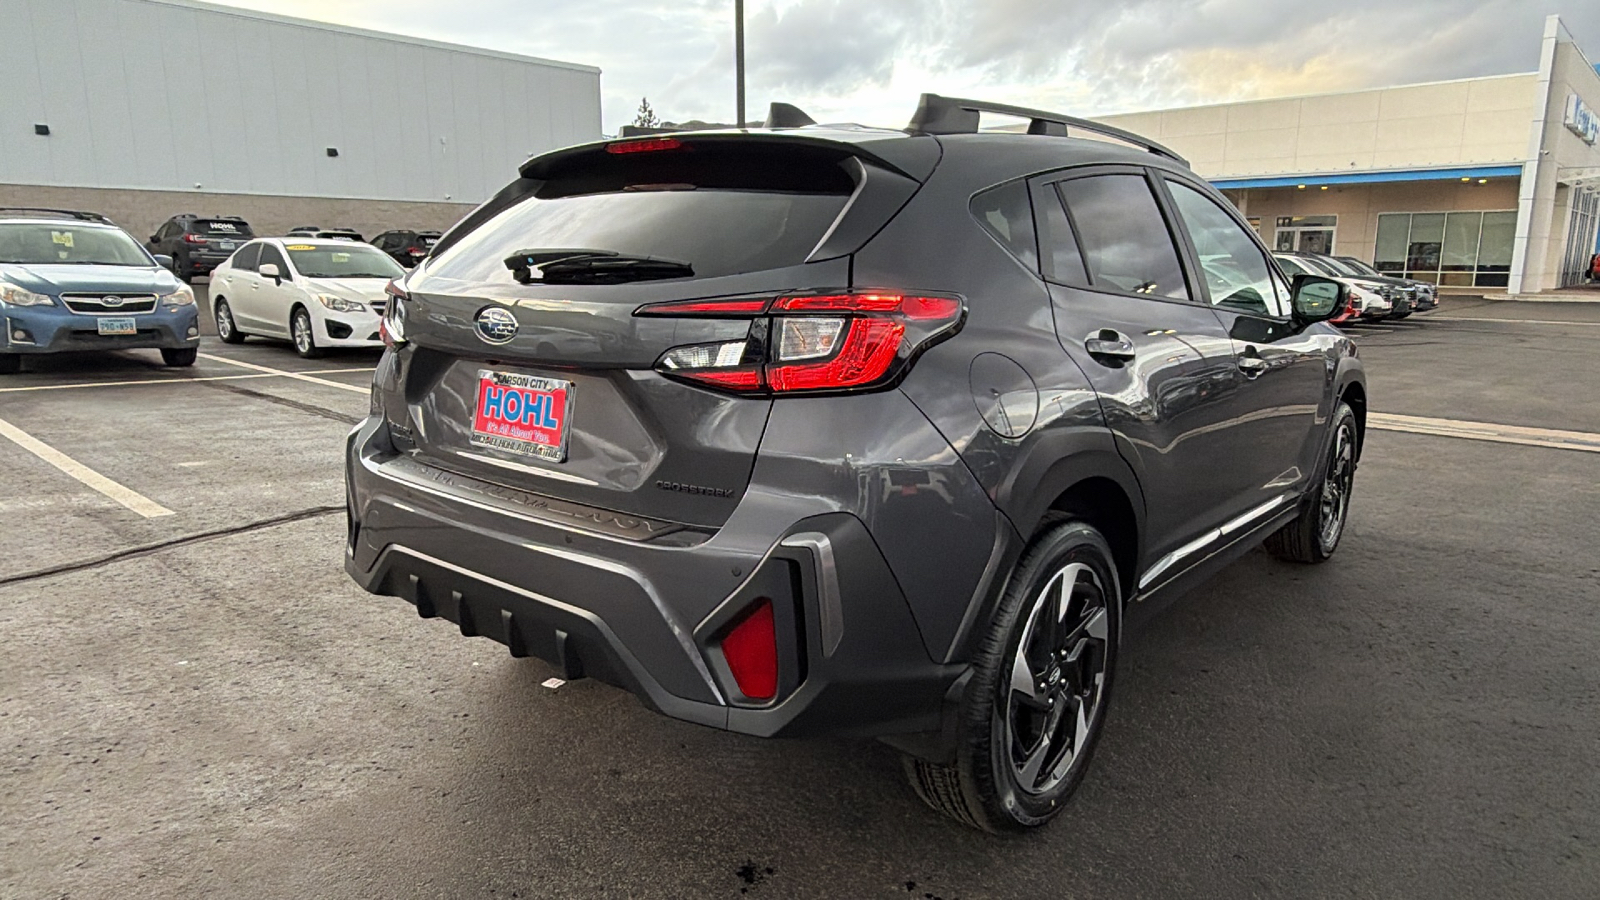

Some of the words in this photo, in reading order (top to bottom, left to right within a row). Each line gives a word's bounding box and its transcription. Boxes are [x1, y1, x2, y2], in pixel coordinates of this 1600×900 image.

[498, 374, 528, 387] CARSON
[530, 379, 549, 389] CITY
[483, 387, 558, 430] HOHL
[486, 421, 498, 432] It's
[499, 423, 509, 434] All
[510, 426, 533, 439] About
[655, 480, 734, 498] CROSSTREK
